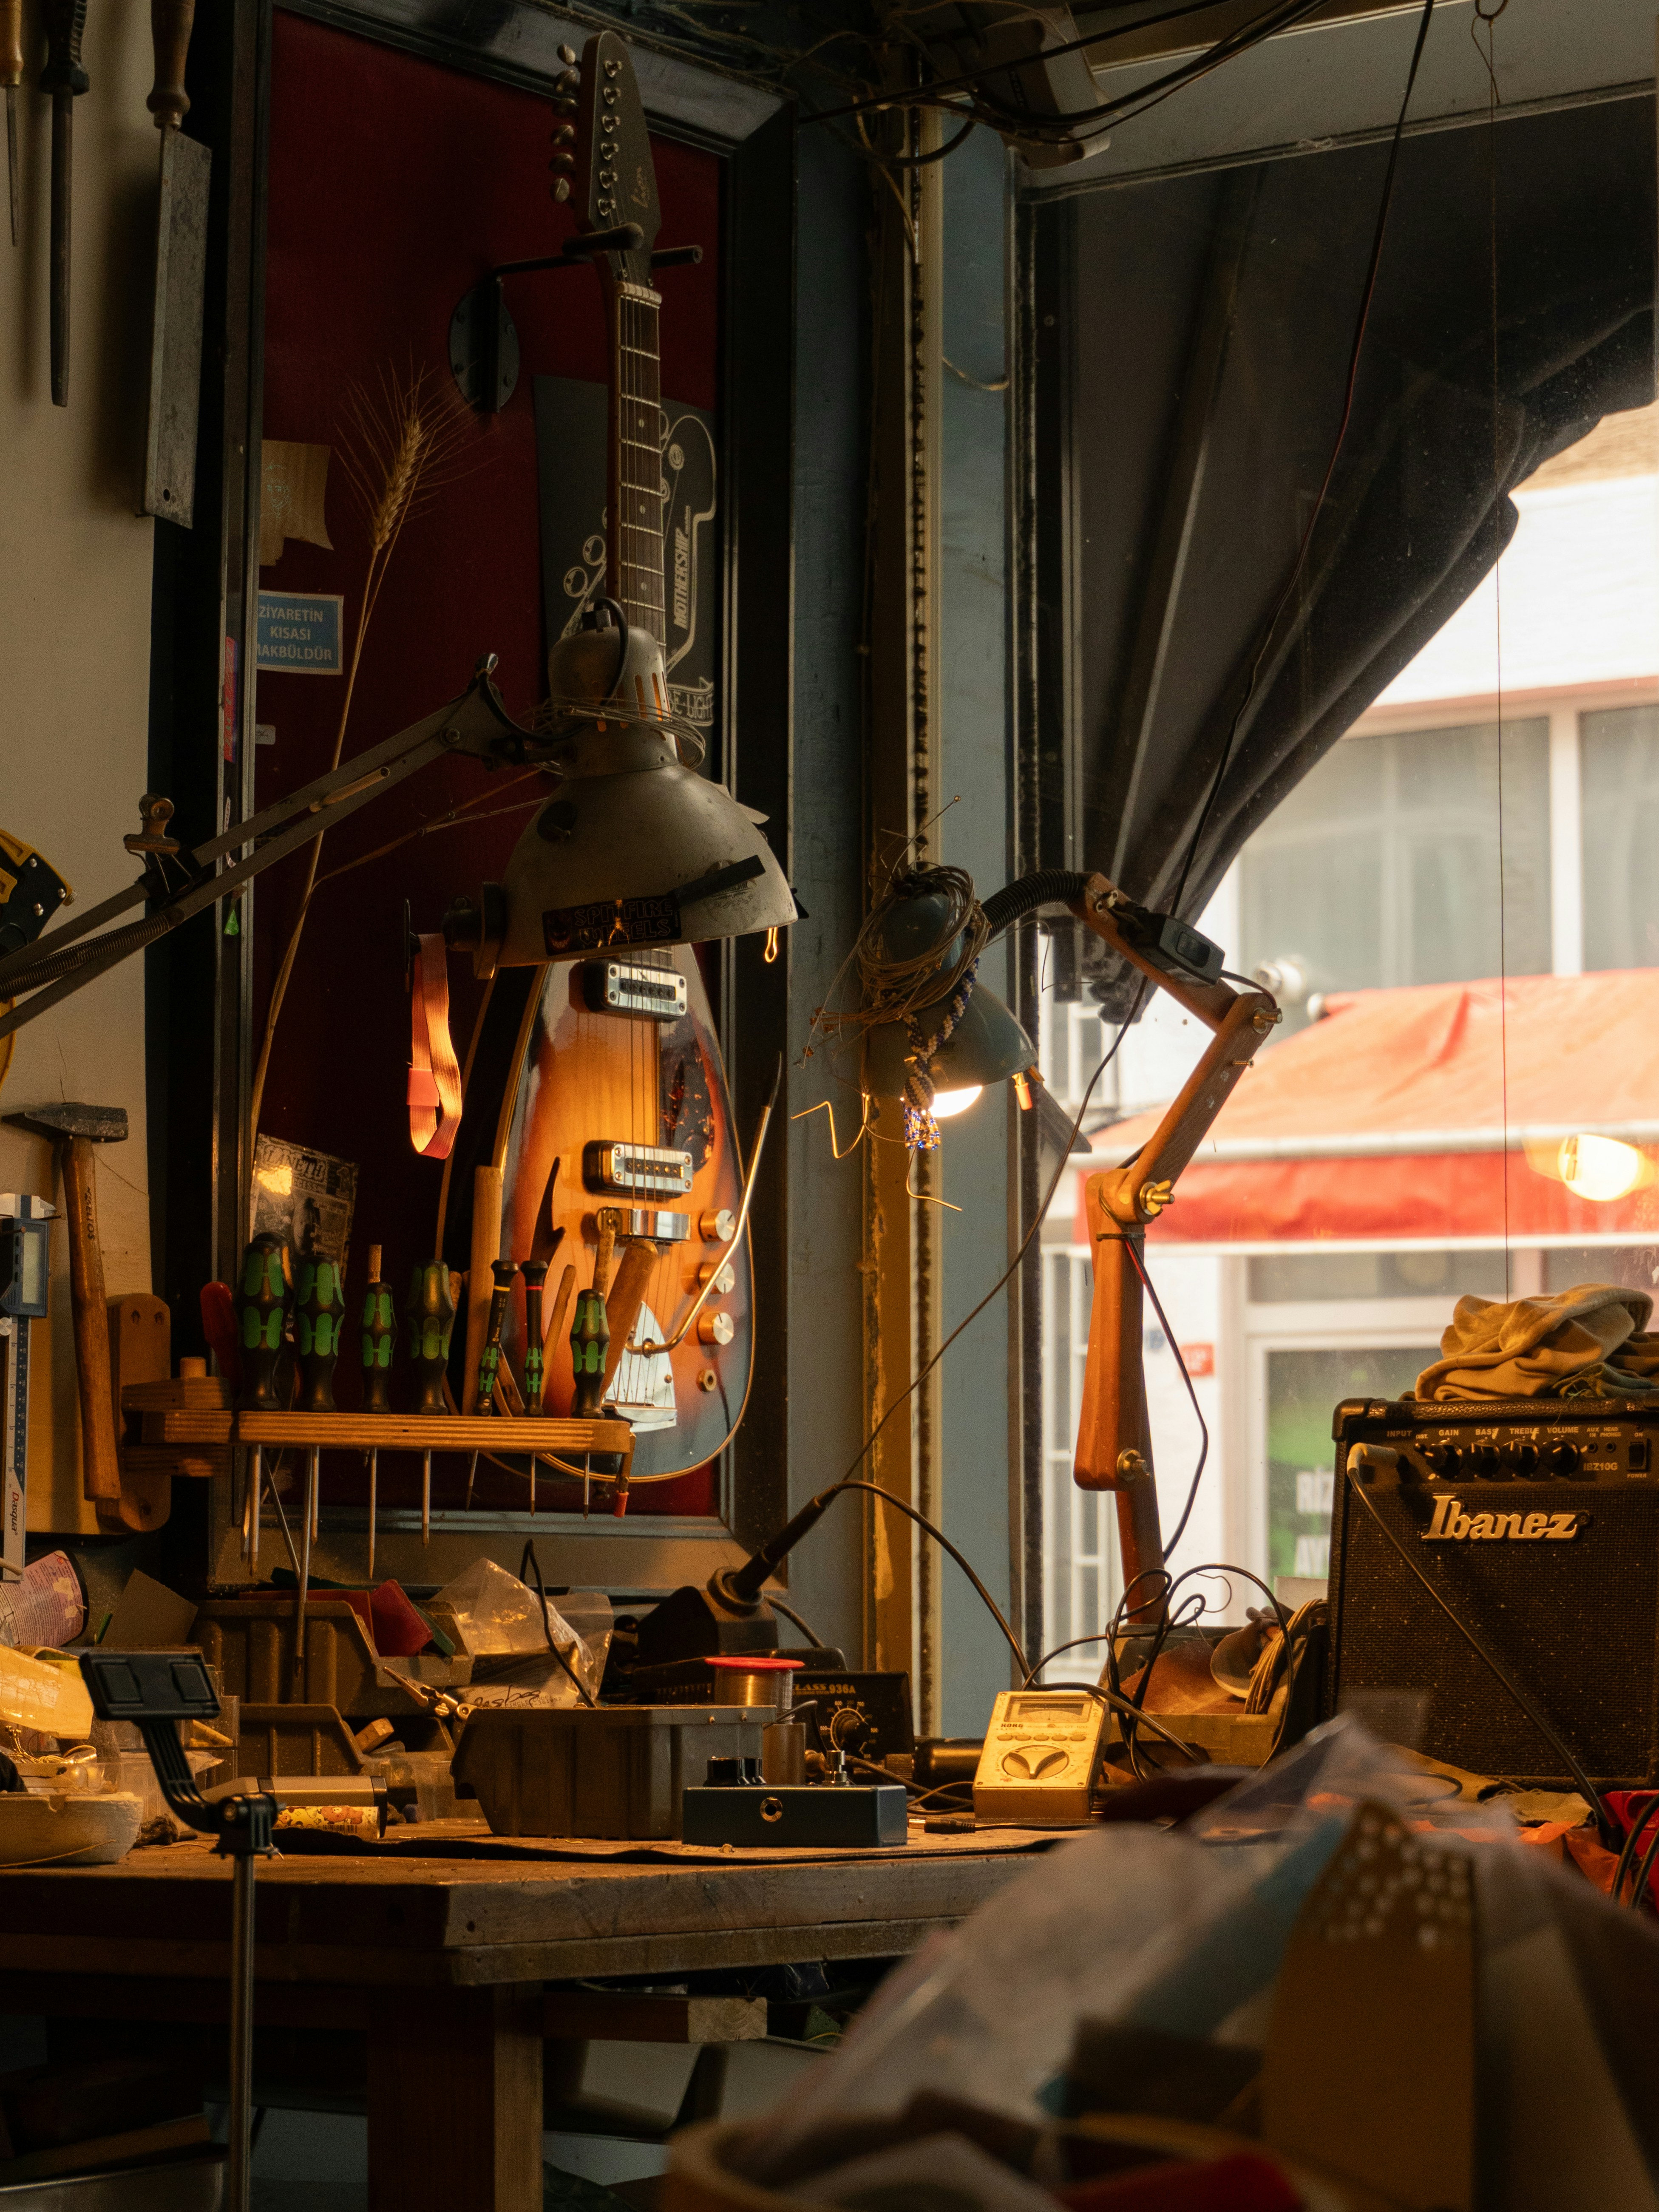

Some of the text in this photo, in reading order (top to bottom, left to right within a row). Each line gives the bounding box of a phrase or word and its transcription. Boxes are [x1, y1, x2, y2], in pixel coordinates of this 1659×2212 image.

[674, 527, 687, 629] MOTHERSHIP
[258, 604, 323, 622] ZİYARETİN
[269, 625, 311, 641] KISASI
[574, 898, 673, 927] SPITFIRE
[579, 919, 672, 946] WHEELS
[1509, 1427, 1540, 1435] TREBLE
[1546, 1426, 1579, 1434] VOLUME
[1583, 1462, 1618, 1471] IBZ10G
[10, 1491, 19, 1531] Dasqua
[1422, 1495, 1578, 1540] Ibanez
[829, 1684, 856, 1694] 936A
